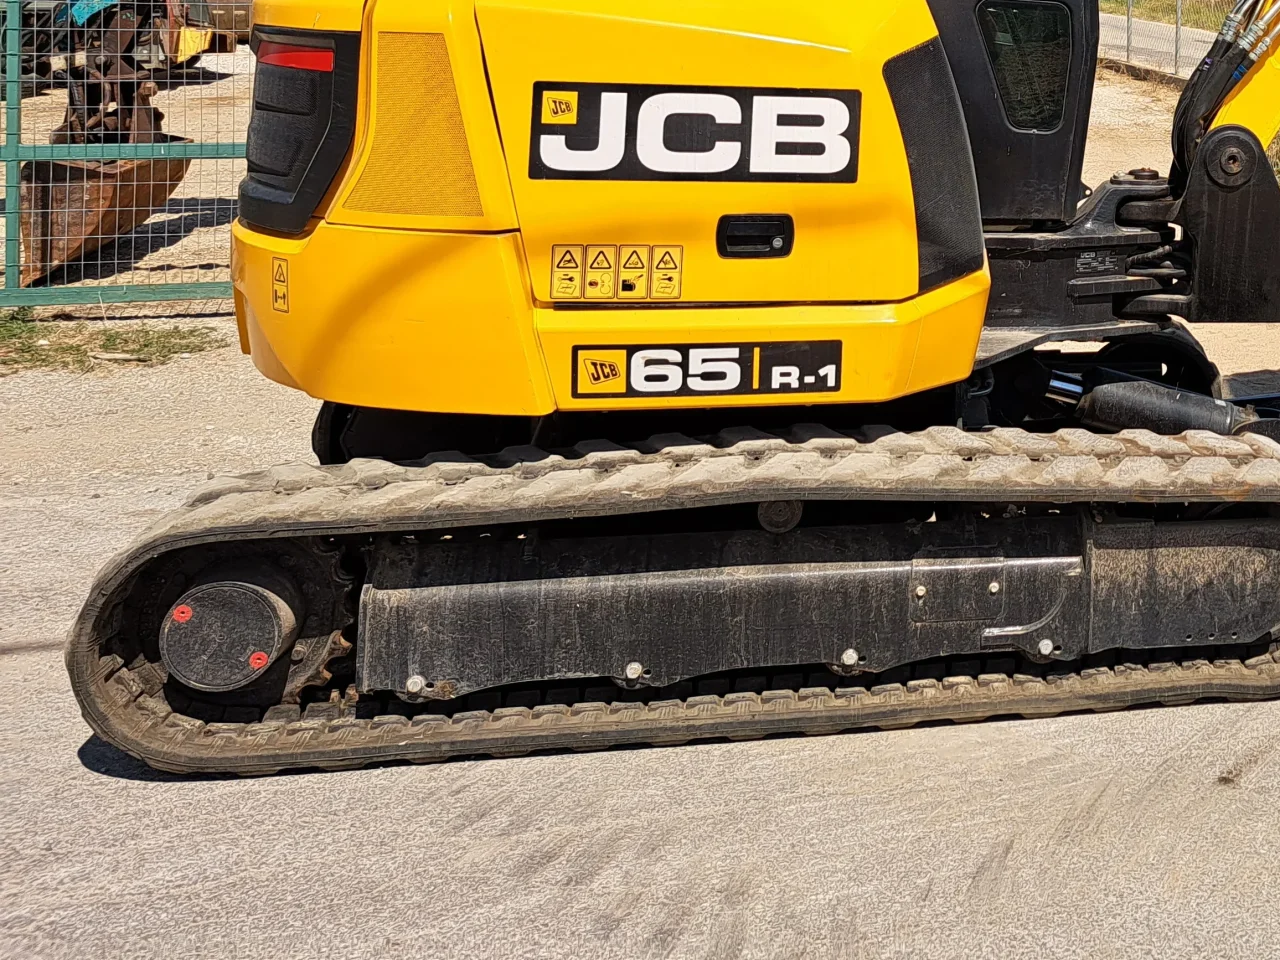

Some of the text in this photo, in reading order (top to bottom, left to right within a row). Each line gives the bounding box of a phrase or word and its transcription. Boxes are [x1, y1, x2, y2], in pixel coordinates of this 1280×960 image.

[551, 99, 573, 116] JCB
[540, 92, 850, 174] JCB
[591, 347, 837, 392] JCB 65 R-1
